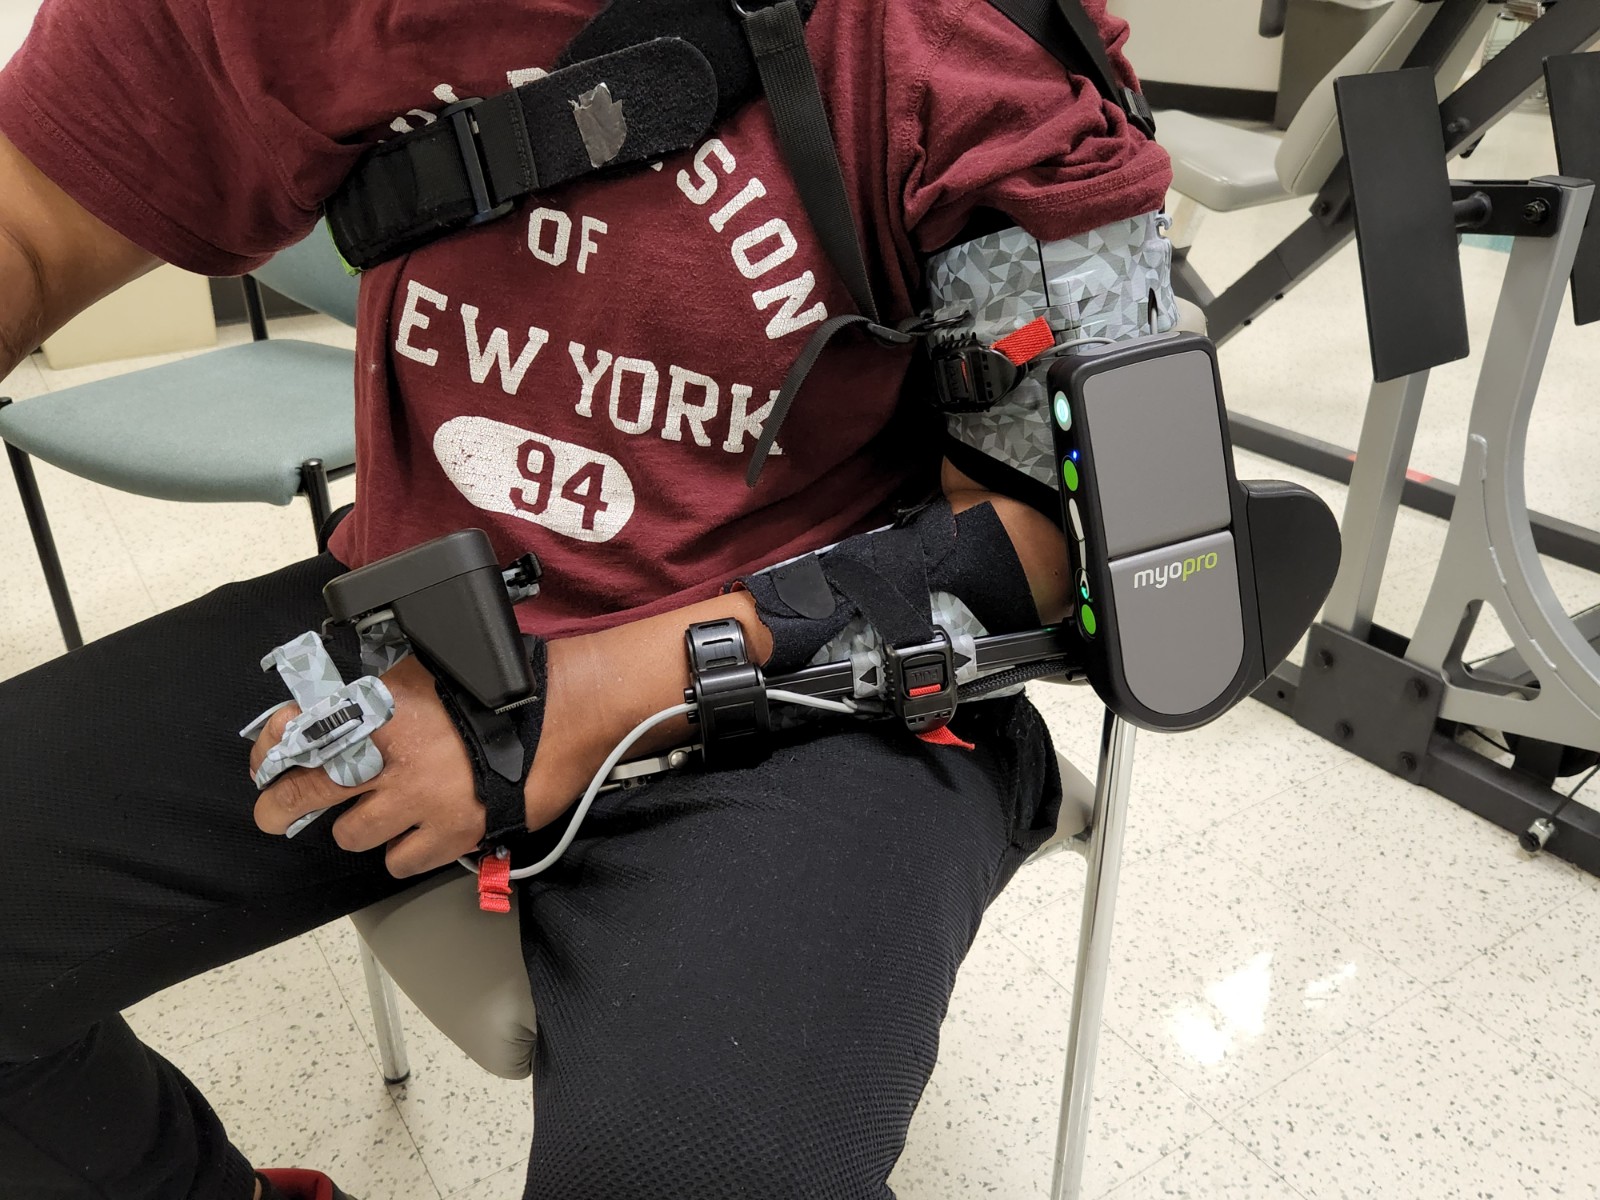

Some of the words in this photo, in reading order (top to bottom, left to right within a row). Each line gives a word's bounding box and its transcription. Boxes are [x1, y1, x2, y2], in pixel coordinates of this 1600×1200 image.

[527, 206, 608, 274] OF
[653, 138, 828, 340] SION
[568, 341, 784, 455] YORK
[509, 438, 609, 531] 94
[1133, 552, 1218, 588] myopro
